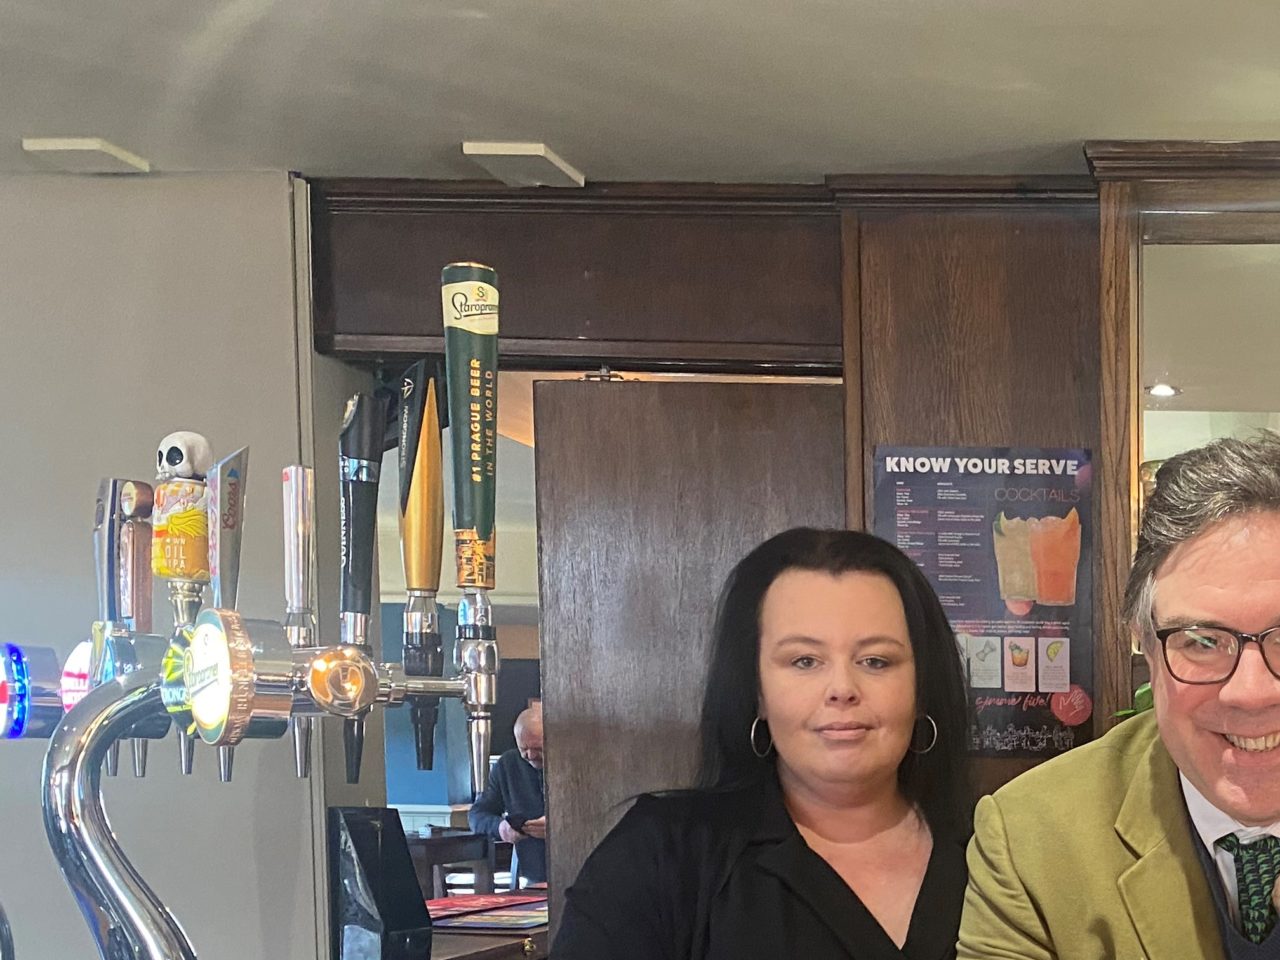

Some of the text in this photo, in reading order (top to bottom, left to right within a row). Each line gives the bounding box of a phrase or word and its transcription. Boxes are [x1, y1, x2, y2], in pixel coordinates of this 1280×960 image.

[470, 359, 481, 397] BEER
[471, 402, 481, 461] PRAGUE
[485, 370, 495, 476] IN THE WORLD
[885, 457, 1079, 476] KNOW YOUR SERVE
[994, 487, 1081, 503] COCKTAILS
[165, 544, 186, 559] OIL
